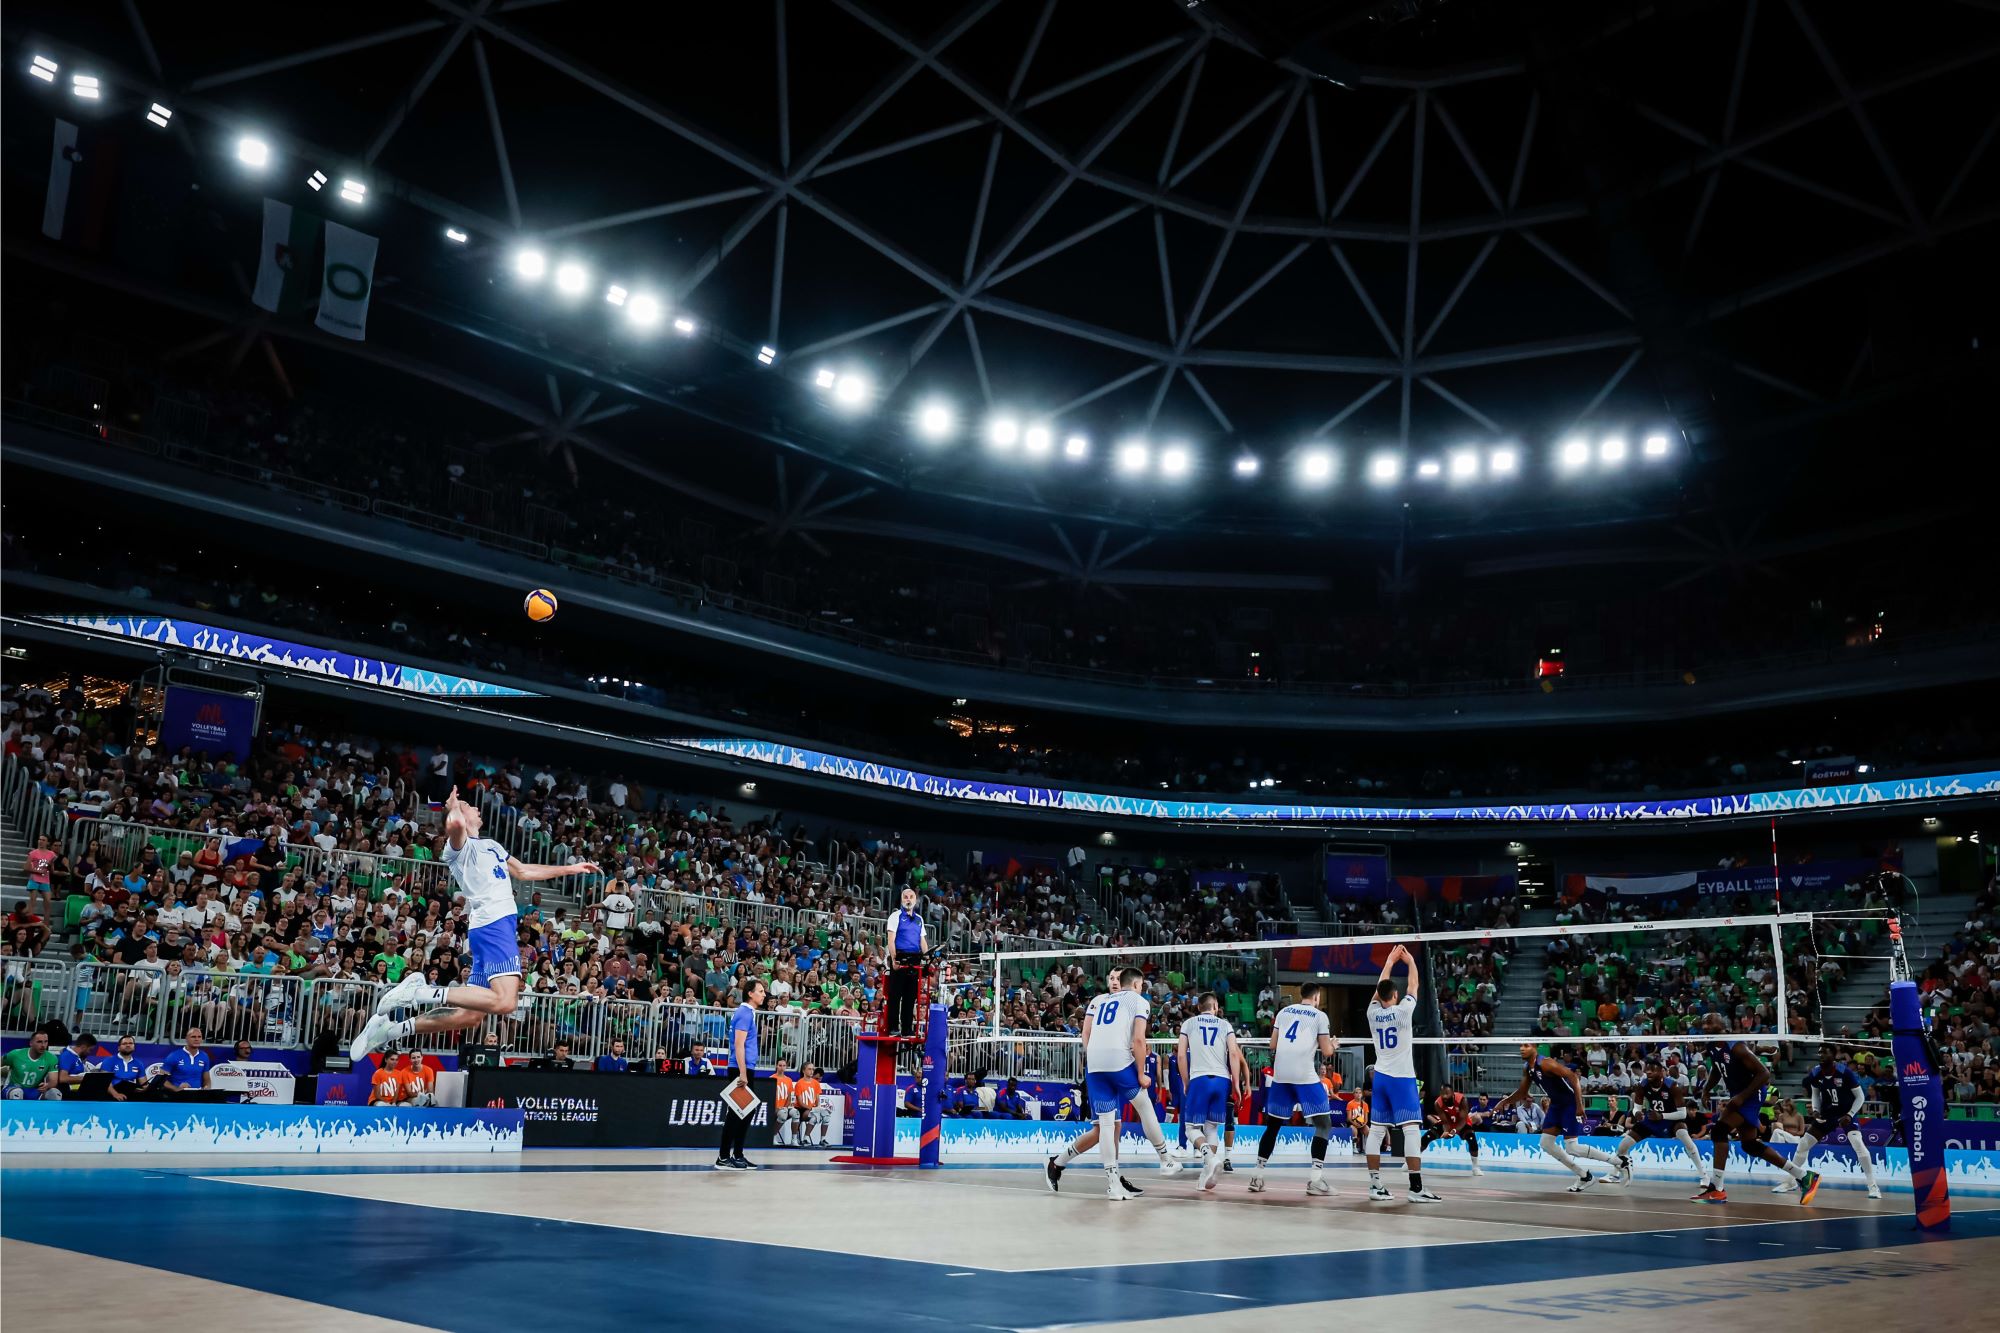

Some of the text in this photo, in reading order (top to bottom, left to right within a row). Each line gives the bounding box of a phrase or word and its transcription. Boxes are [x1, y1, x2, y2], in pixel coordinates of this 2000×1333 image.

[1697, 879, 1752, 895] EYBALL
[1097, 1000, 1119, 1025] 18
[1199, 1025, 1218, 1046] 17
[1285, 1020, 1300, 1043] 4
[1375, 1026, 1398, 1050] 16
[22, 1071, 37, 1086] 13
[516, 1096, 599, 1111] VOLLEYBALL
[668, 1099, 768, 1126] LJUBLA
[1652, 1100, 1665, 1112] 23
[523, 1111, 599, 1122] ATIONS LEAGUE
[1913, 1110, 1926, 1162] Senoh
[1509, 1287, 1751, 1313] FEEL
